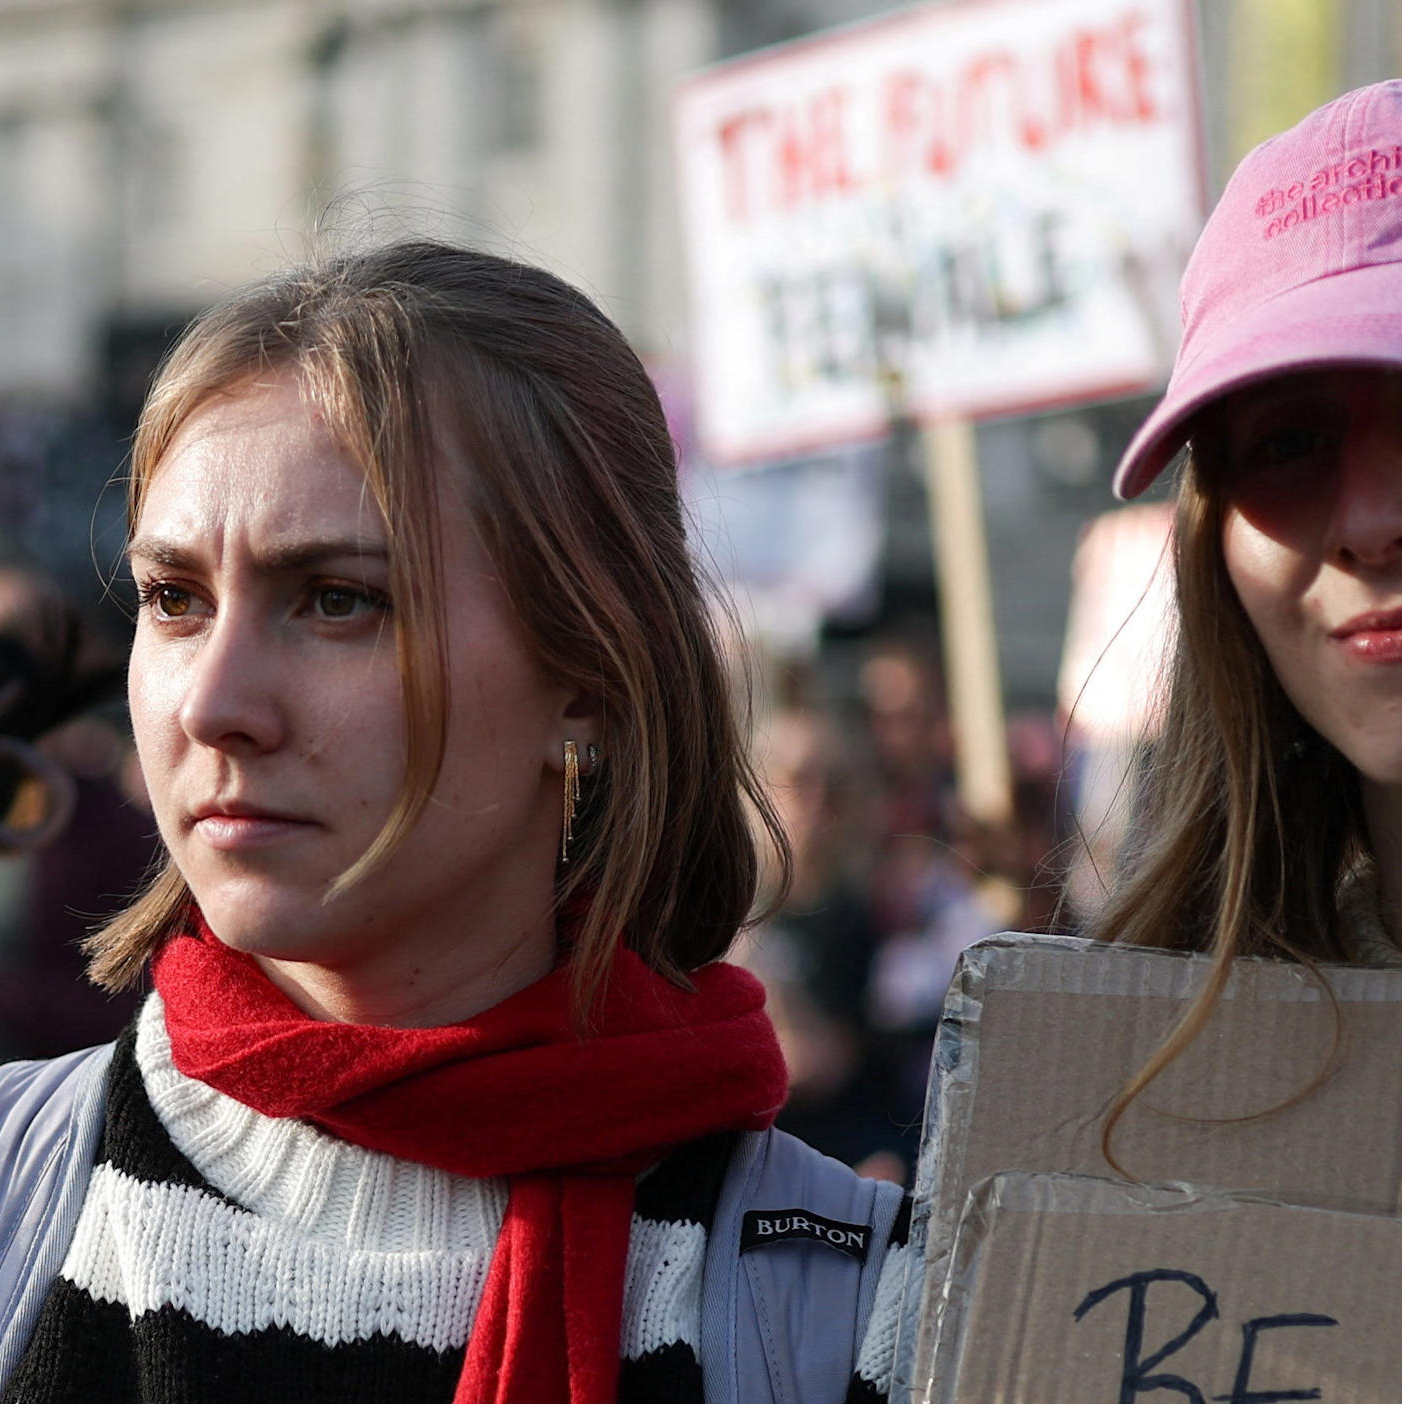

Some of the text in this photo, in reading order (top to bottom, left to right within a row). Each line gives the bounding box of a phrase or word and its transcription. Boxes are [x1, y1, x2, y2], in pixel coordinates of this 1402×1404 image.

[717, 10, 1157, 226] THE FUTURE
[1254, 180, 1304, 217] the
[756, 1216, 865, 1249] BURTON
